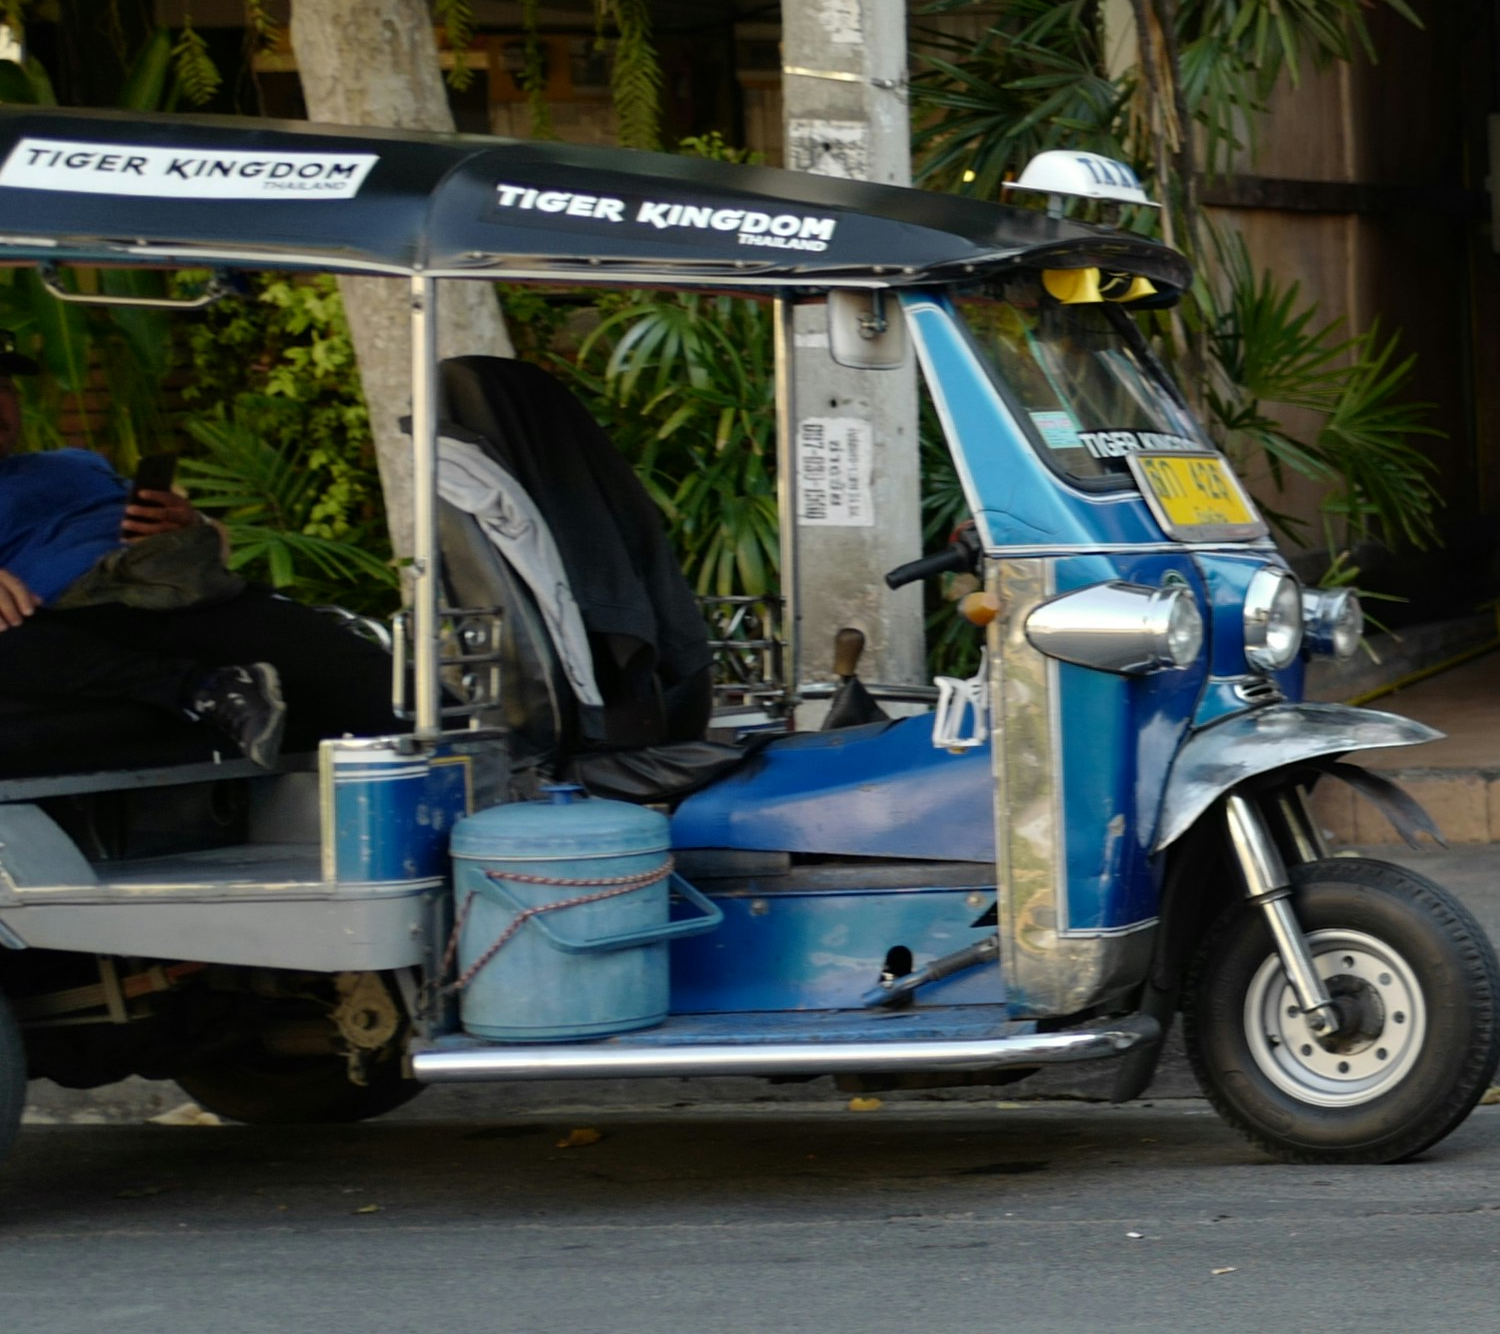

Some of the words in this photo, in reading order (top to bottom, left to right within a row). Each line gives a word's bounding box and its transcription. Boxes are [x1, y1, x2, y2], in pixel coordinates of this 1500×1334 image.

[26, 148, 148, 176] TIGER
[164, 158, 359, 181] KINGDOM
[262, 180, 348, 192] THAILAND
[496, 184, 627, 222] TIGER
[636, 201, 837, 241] KINGDOM
[737, 233, 828, 252] THAILAND
[1077, 431, 1140, 458] TIGER
